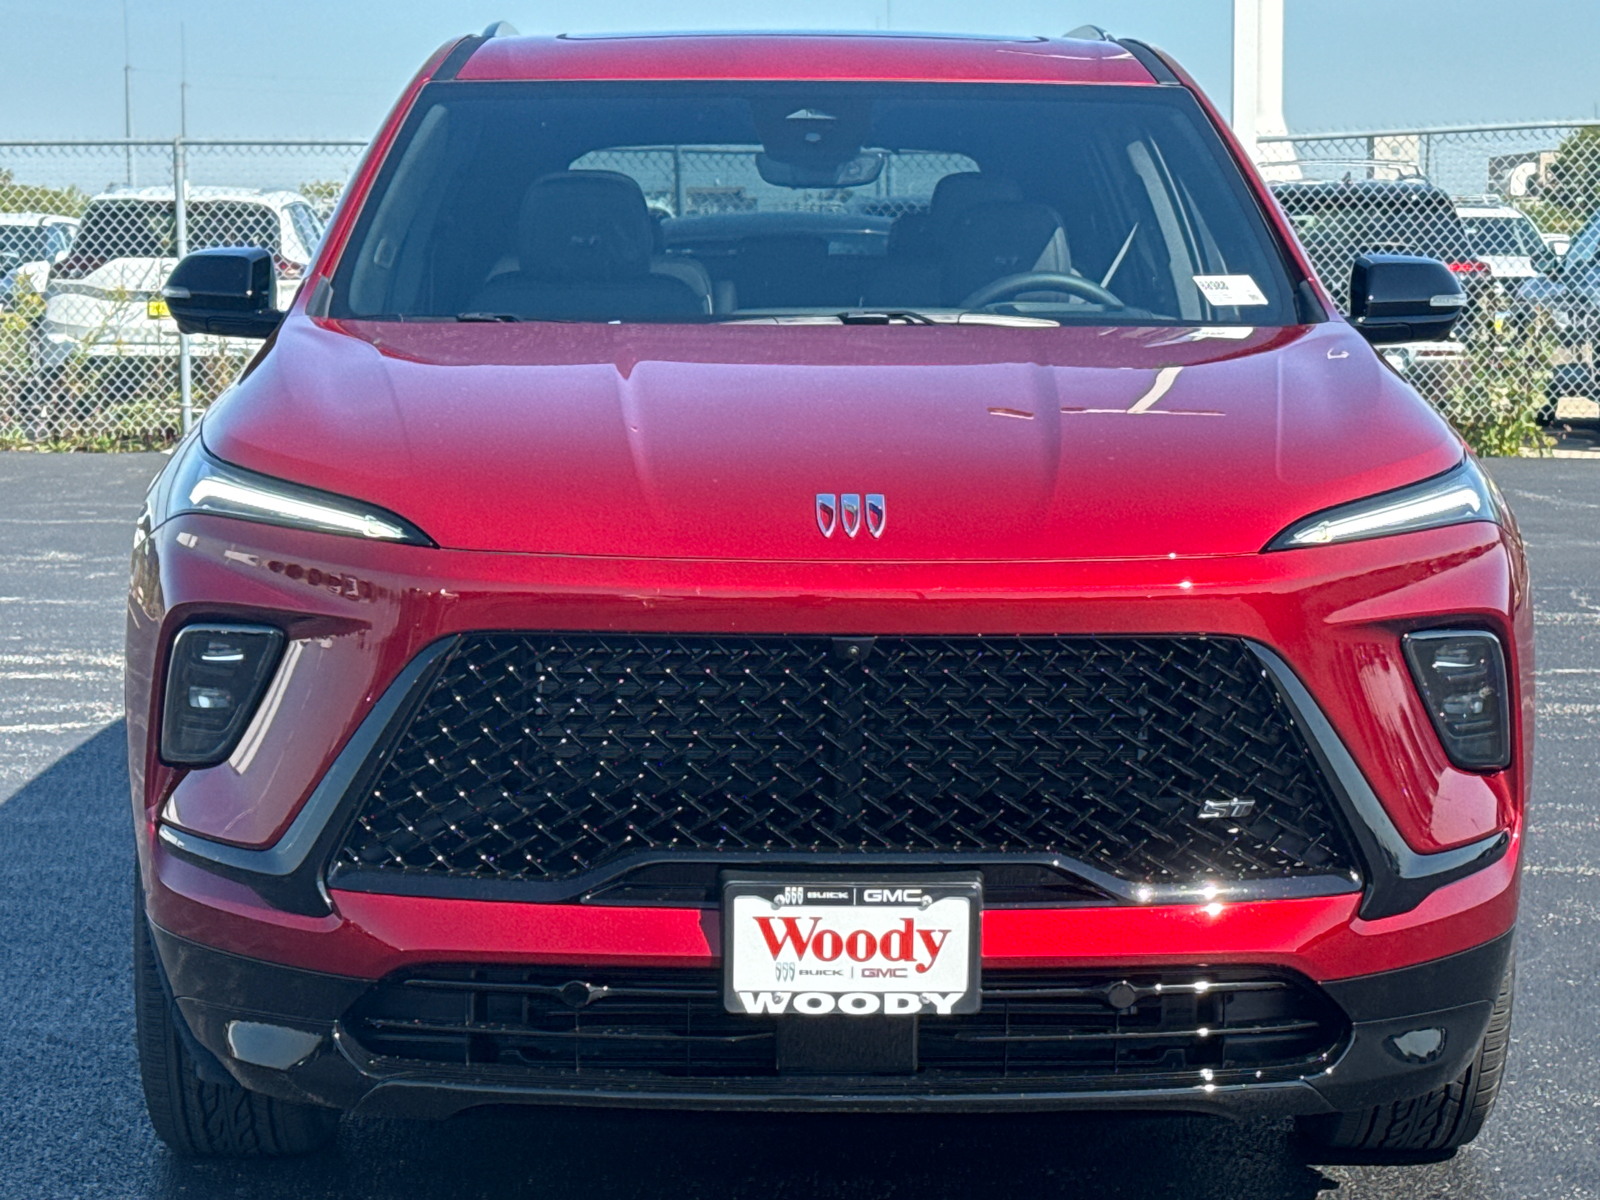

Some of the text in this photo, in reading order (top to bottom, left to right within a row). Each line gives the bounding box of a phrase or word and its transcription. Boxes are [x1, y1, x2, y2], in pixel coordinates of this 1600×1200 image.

[807, 889, 922, 902] BUICK GMC
[752, 916, 952, 974] Woody
[861, 967, 908, 978] GMC
[738, 991, 965, 1015] WOODY
